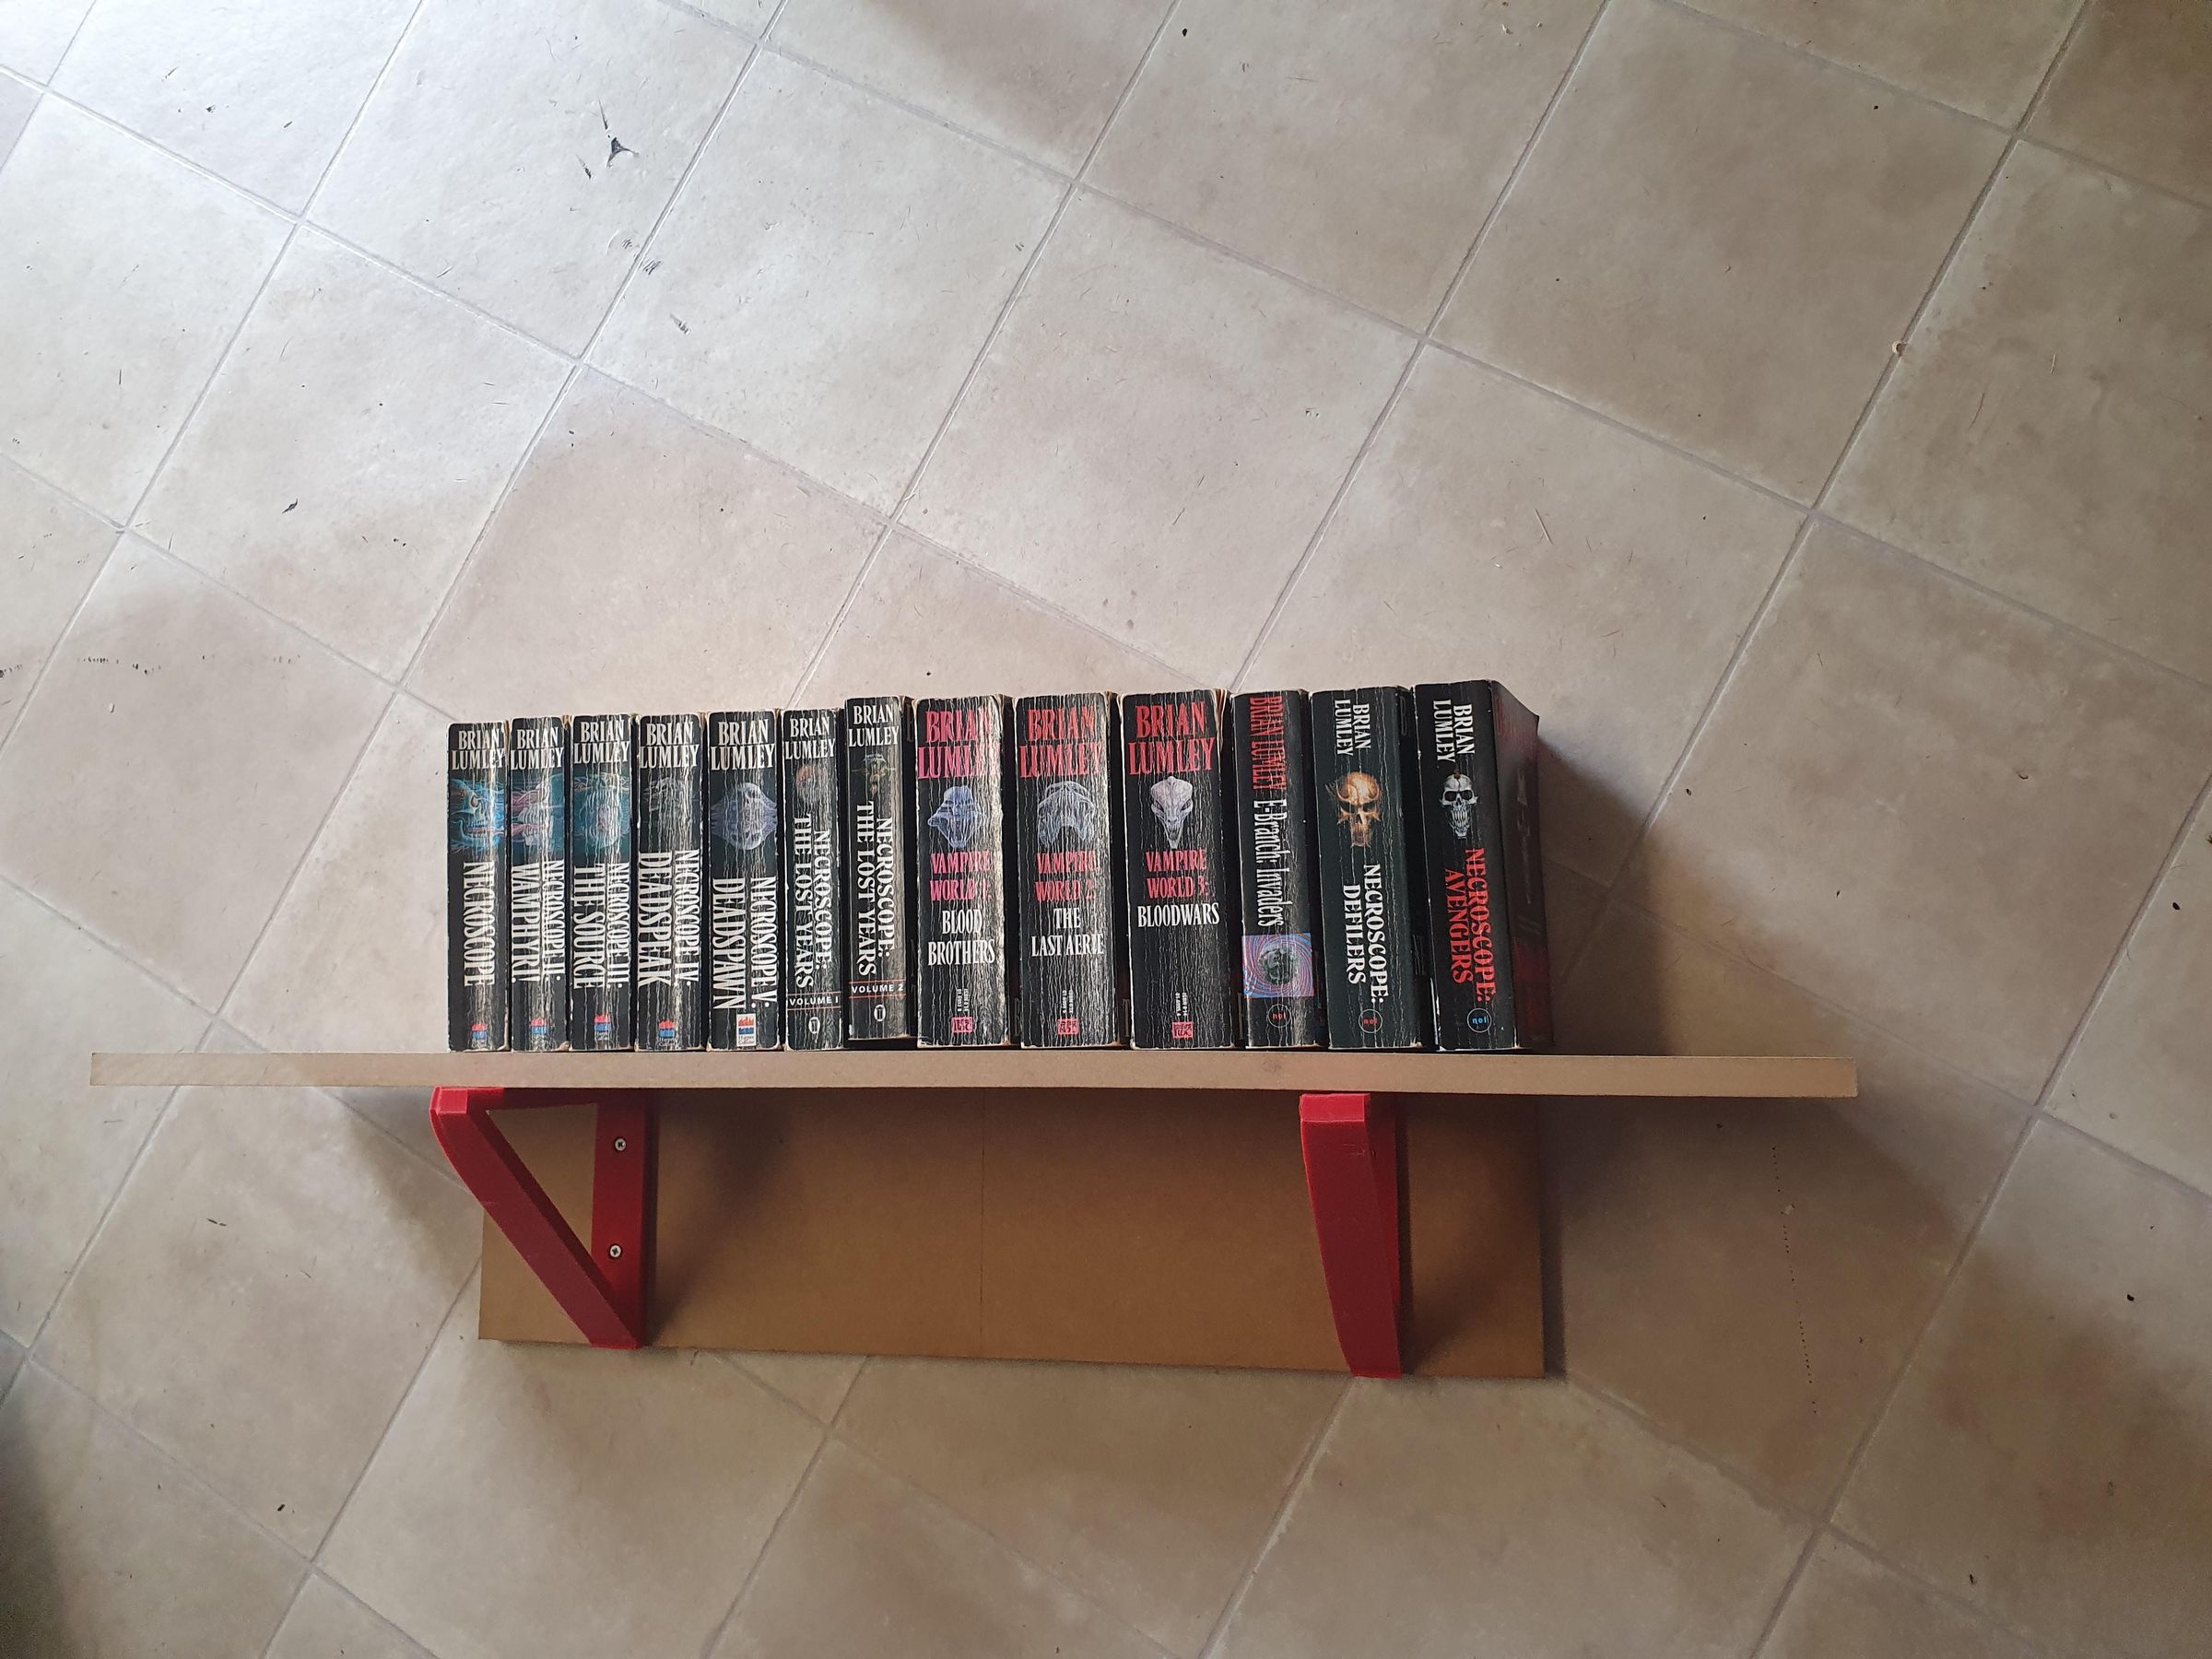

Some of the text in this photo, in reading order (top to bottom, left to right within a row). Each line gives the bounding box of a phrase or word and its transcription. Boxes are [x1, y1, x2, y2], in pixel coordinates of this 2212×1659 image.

[790, 716, 830, 738] BRIAN
[853, 705, 894, 726] BRIAN
[1028, 705, 1095, 742] BRIAN
[1135, 701, 1206, 738] BRIAN
[1335, 699, 1354, 757] LUMLEY
[1352, 703, 1372, 749] BRIAN
[1453, 703, 1476, 755] BRIAN
[458, 728, 500, 750] BRIAN
[516, 726, 559, 749] BRIAN
[580, 720, 624, 743] BRIAN
[646, 721, 694, 746] BRIAN
[718, 719, 769, 746] BRIAN
[848, 725, 900, 747] LUMLEY
[1432, 699, 1456, 763] LUMLEY
[452, 747, 505, 771] LUMLEY
[511, 747, 564, 771] LUMLEY
[573, 741, 630, 764] LUMLEY
[640, 743, 700, 769] LUMLEY
[711, 743, 775, 771] LUMLEY
[784, 738, 836, 760] LUMLEY
[1019, 740, 1102, 778] LUMLEY
[1128, 737, 1216, 775] LUMLEY
[1250, 695, 1293, 927] BRIAN LUMLEY E-Branch: Invaders
[930, 851, 990, 875] VAMPIRE
[1146, 849, 1207, 873] VAMPIRE
[794, 813, 814, 989] THE LOST YEARS
[856, 800, 877, 977] THE LOST YEARS
[876, 817, 896, 958] NECROSCOPE:
[930, 878, 977, 901] WORLD
[1035, 878, 1082, 901] WORLD
[1147, 877, 1195, 900] WORLD
[542, 859, 565, 958] NECROSCOPE
[606, 862, 630, 958] NECROSCOPE
[675, 849, 700, 956] NECROSCOPE
[1137, 902, 1220, 928] BLOODWARS
[464, 862, 496, 987] NECROSCOPE
[512, 863, 541, 983] WAMPHYRI!
[573, 863, 606, 990] THE SOURCE
[638, 850, 673, 988] DEADSPEAK
[750, 876, 778, 987] NECROSCOPE
[942, 909, 983, 935] BLOOD
[1053, 907, 1082, 929] THE
[1444, 868, 1474, 984] AVENGERS
[1465, 847, 1497, 1003] NECROSCOPE:
[712, 877, 747, 1009] DEADSPAWN
[1031, 933, 1104, 957] LAST AERIE
[1343, 884, 1366, 984] DEFILERS
[1363, 864, 1390, 1004] NECROSCOPE:
[928, 938, 995, 966] BROTHERS
[789, 996, 832, 1006] VOLUME
[852, 983, 904, 994] VOLUME 2
